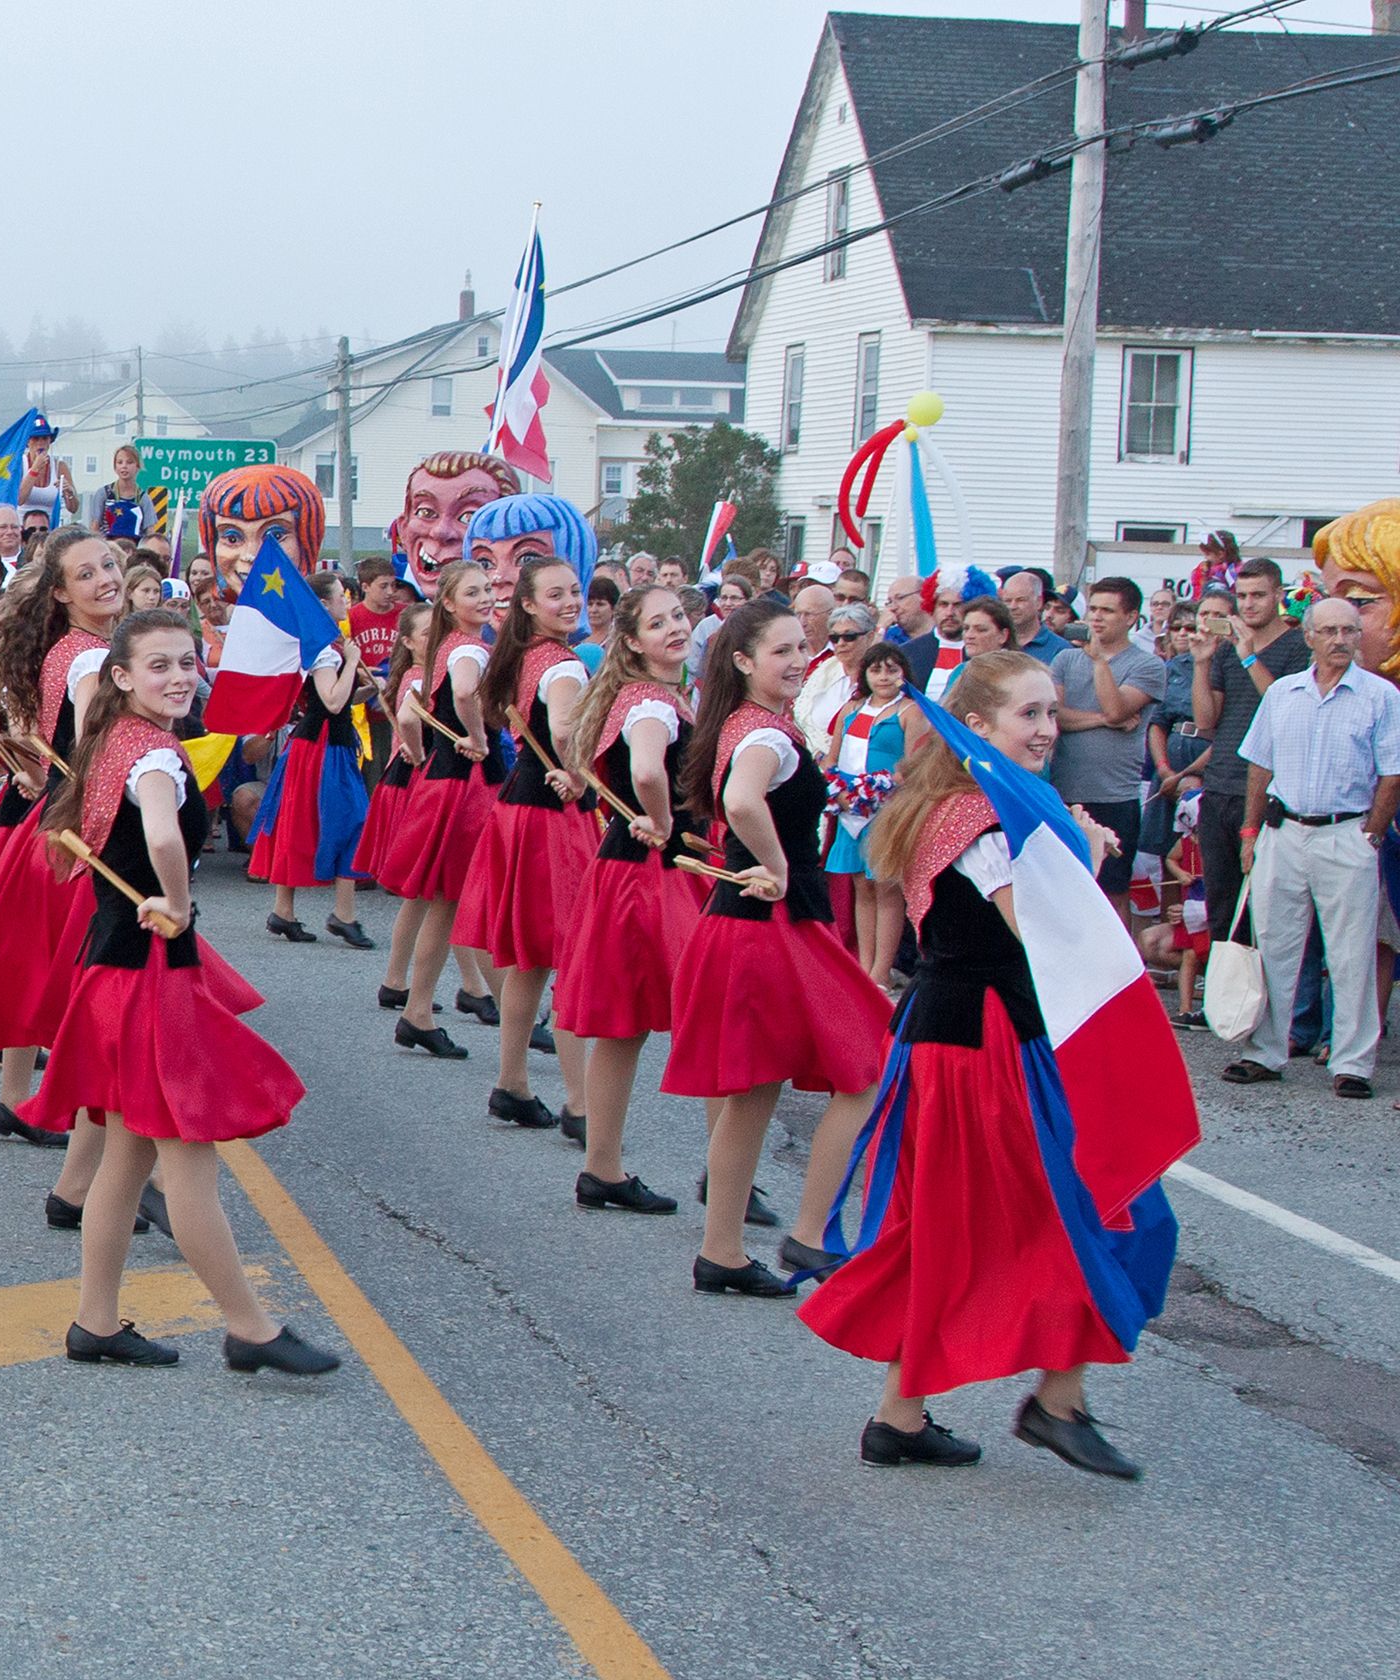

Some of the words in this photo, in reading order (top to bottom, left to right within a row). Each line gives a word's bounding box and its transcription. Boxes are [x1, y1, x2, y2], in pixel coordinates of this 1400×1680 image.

[140, 446, 236, 463] Weymouth
[244, 448, 269, 462] 23
[161, 466, 214, 485] Digby
